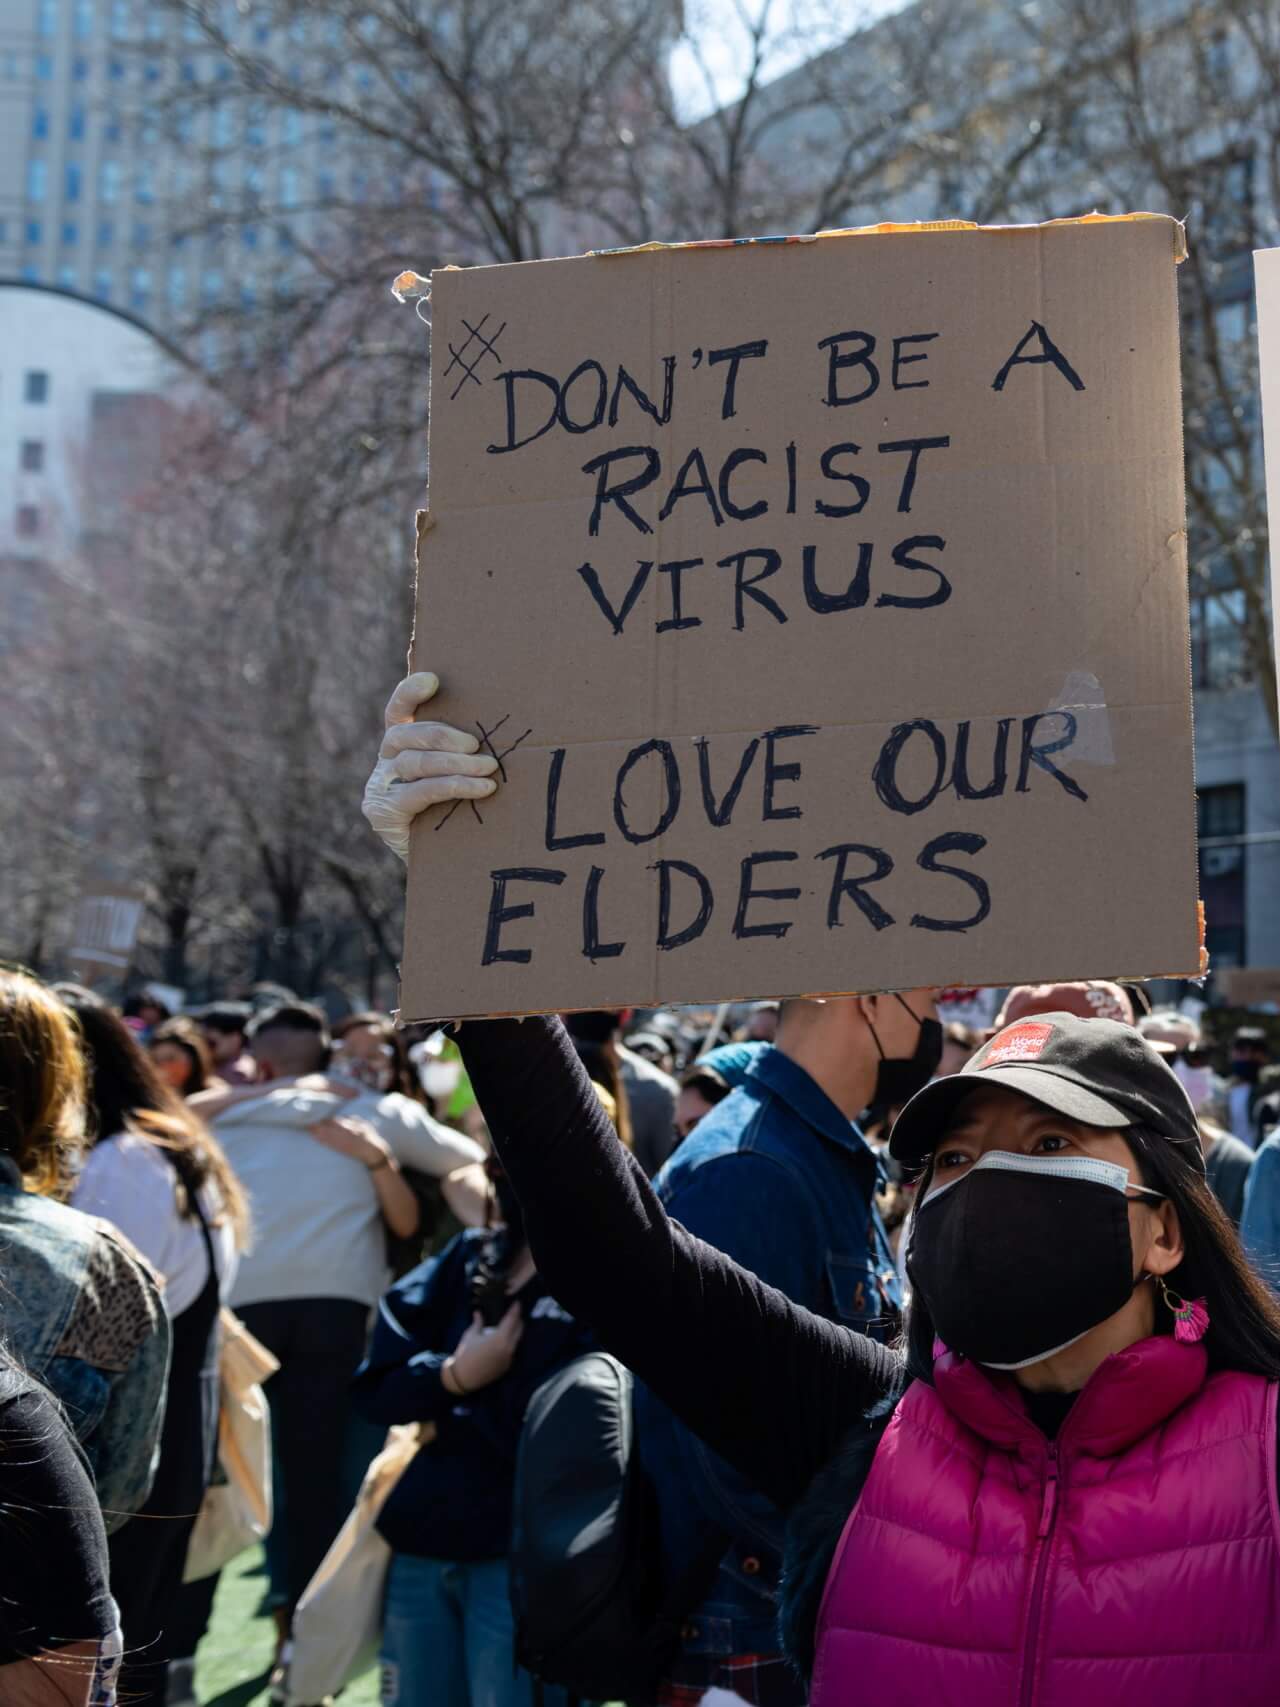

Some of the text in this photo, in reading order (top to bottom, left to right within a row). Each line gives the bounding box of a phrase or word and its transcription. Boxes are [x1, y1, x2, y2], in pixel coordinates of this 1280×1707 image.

[817, 330, 940, 407] BE
[990, 320, 1085, 392] A
[581, 435, 951, 537] RACIST
[577, 535, 953, 635] VIRUS
[872, 711, 1089, 818] OUR
[481, 831, 992, 967] ELDERS
